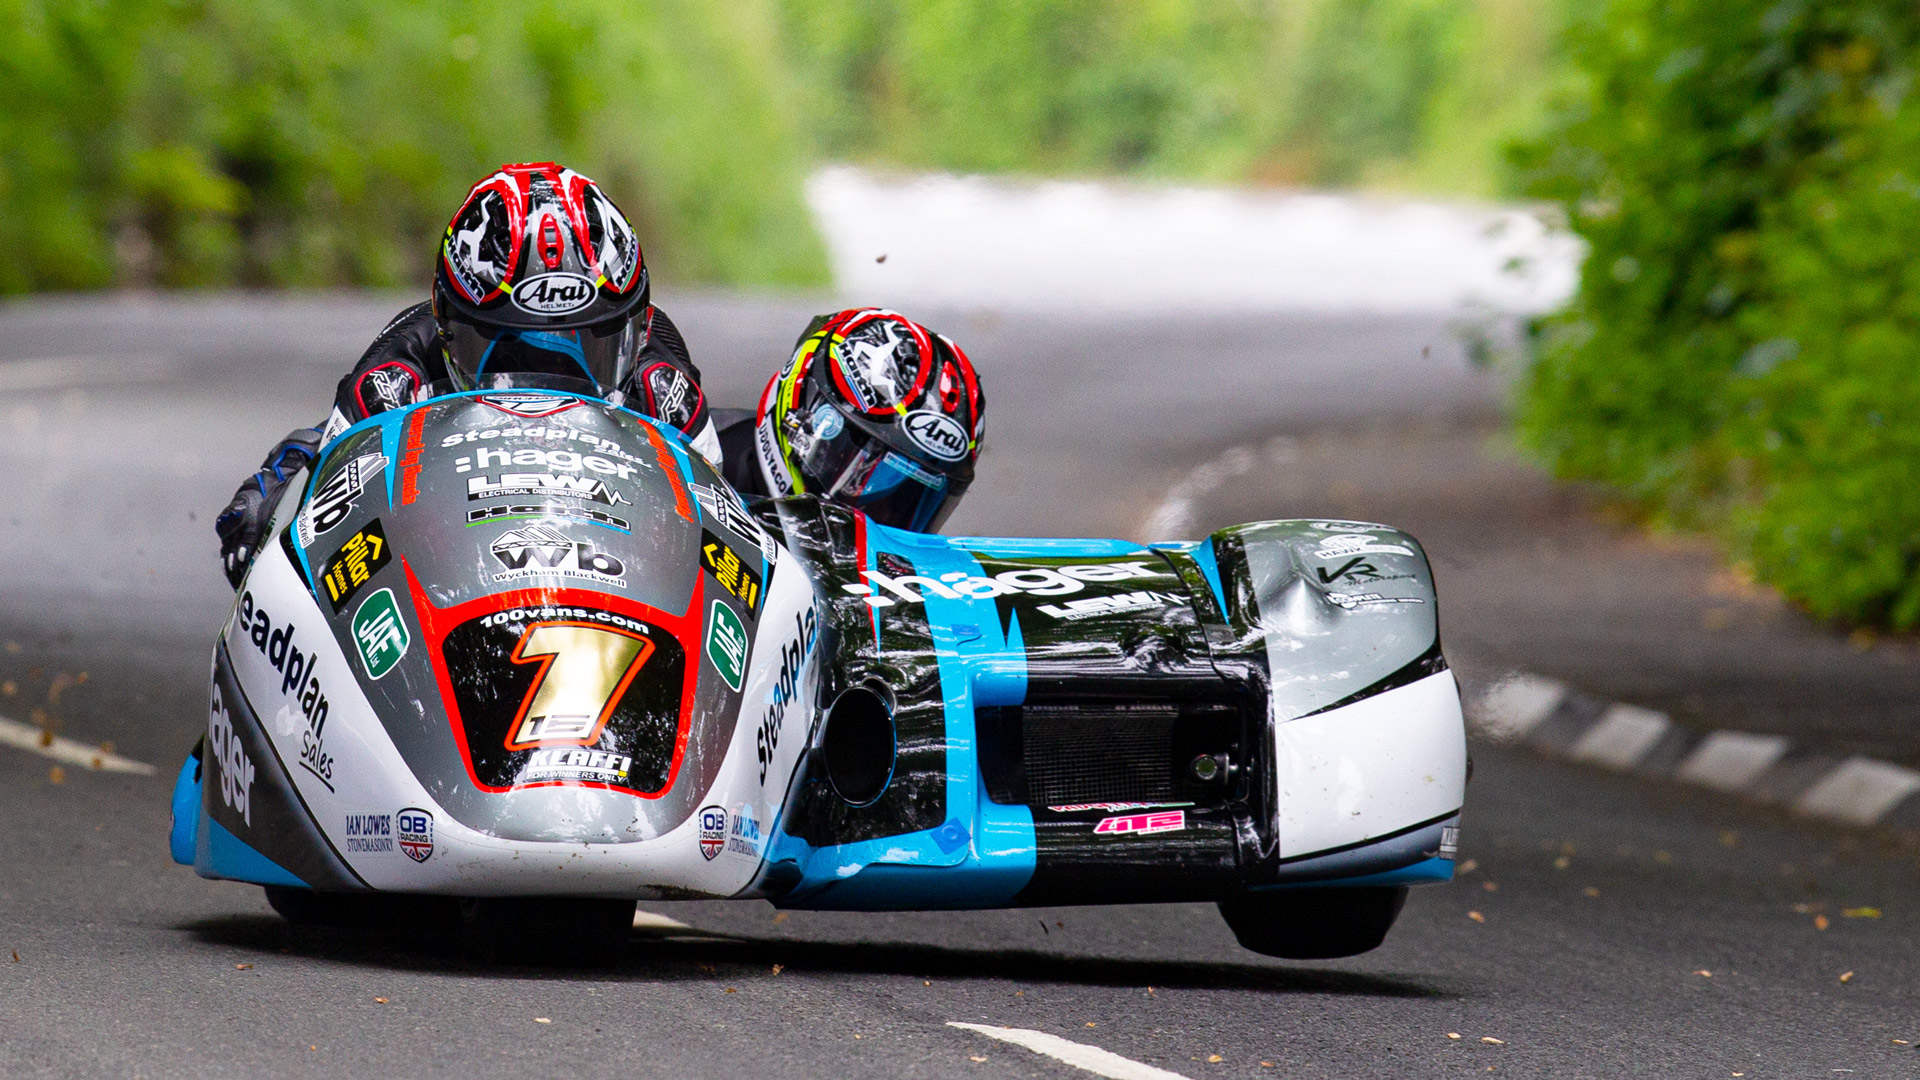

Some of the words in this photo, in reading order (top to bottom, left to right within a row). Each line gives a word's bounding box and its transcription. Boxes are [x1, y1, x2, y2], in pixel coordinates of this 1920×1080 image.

[519, 280, 586, 304] Arai
[661, 369, 689, 424] RST
[441, 426, 620, 453] Steadplan
[908, 419, 967, 451] Arai
[468, 474, 600, 493] LEW
[479, 488, 530, 498] ELECTRICAL
[532, 488, 593, 500] DISTRIBUTORS
[341, 531, 370, 588] Pillar
[716, 545, 740, 597] Pillar
[332, 561, 348, 595] Homes
[494, 569, 560, 581] Wyckham
[563, 570, 627, 588] Blackwell
[738, 572, 750, 601] Homes
[358, 607, 402, 660] JAF
[480, 608, 650, 634] 100vans.com
[714, 612, 744, 677] JAF
[238, 590, 329, 739] eadplan
[509, 622, 650, 748] 1
[757, 594, 820, 788] Steadpla
[209, 683, 255, 828] ager
[301, 730, 333, 780] Sales
[526, 771, 548, 780] FOR
[549, 771, 596, 780] WINNERS
[597, 773, 625, 783] ONLY
[346, 815, 361, 835] IAN
[363, 814, 391, 835] LOWES
[400, 815, 427, 834] OB
[702, 831, 724, 840] RACING
[704, 814, 724, 830] OB
[347, 837, 394, 852] STONEMASONRY
[400, 833, 429, 842] RACING
